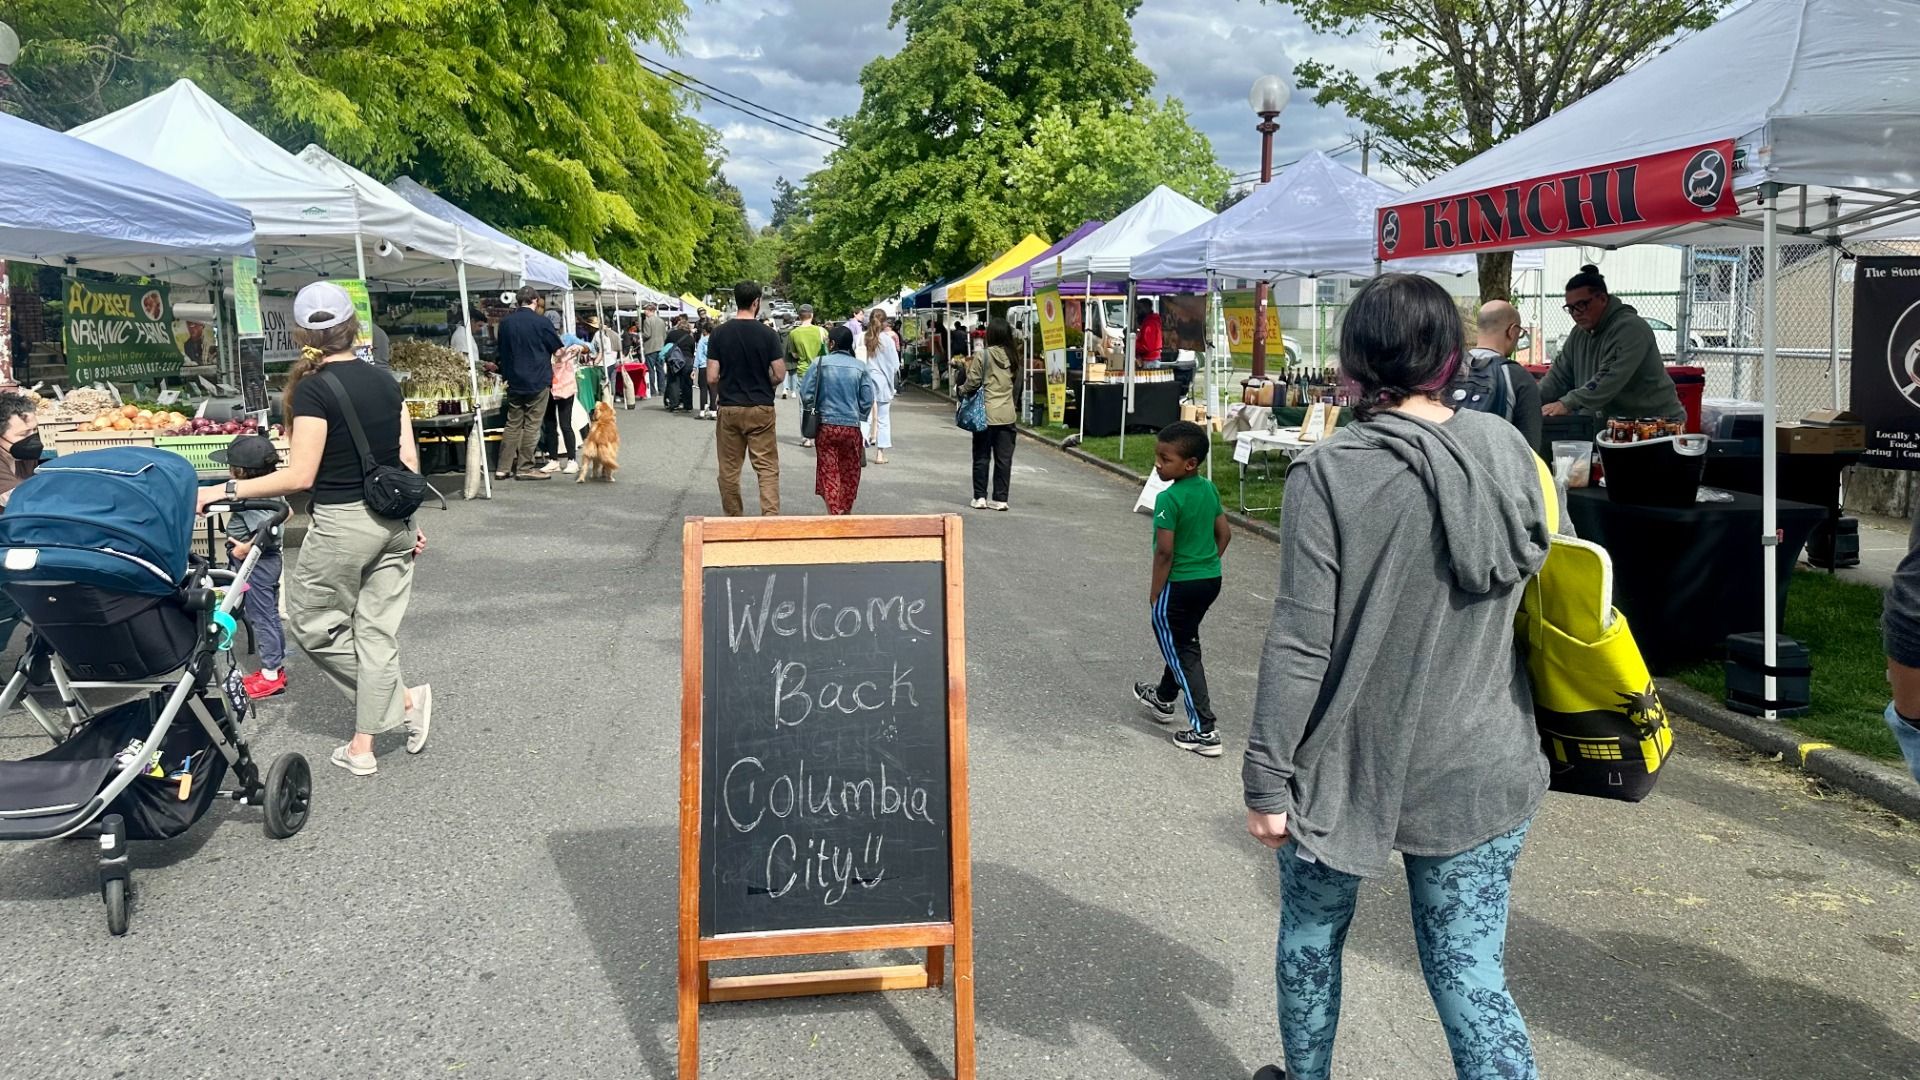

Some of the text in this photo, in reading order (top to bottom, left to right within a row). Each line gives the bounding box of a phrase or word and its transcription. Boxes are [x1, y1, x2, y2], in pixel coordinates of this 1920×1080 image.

[1422, 164, 1646, 250] KIMCHI
[1864, 267, 1887, 278] The
[262, 311, 286, 331] LOW
[71, 319, 171, 352] ORGANIC FARMS
[1876, 430, 1910, 441] Locally
[1889, 440, 1918, 449] Foods
[1862, 448, 1892, 457] aring
[726, 572, 932, 653] Welcome
[772, 659, 919, 730] Back
[723, 756, 937, 832] Columbia
